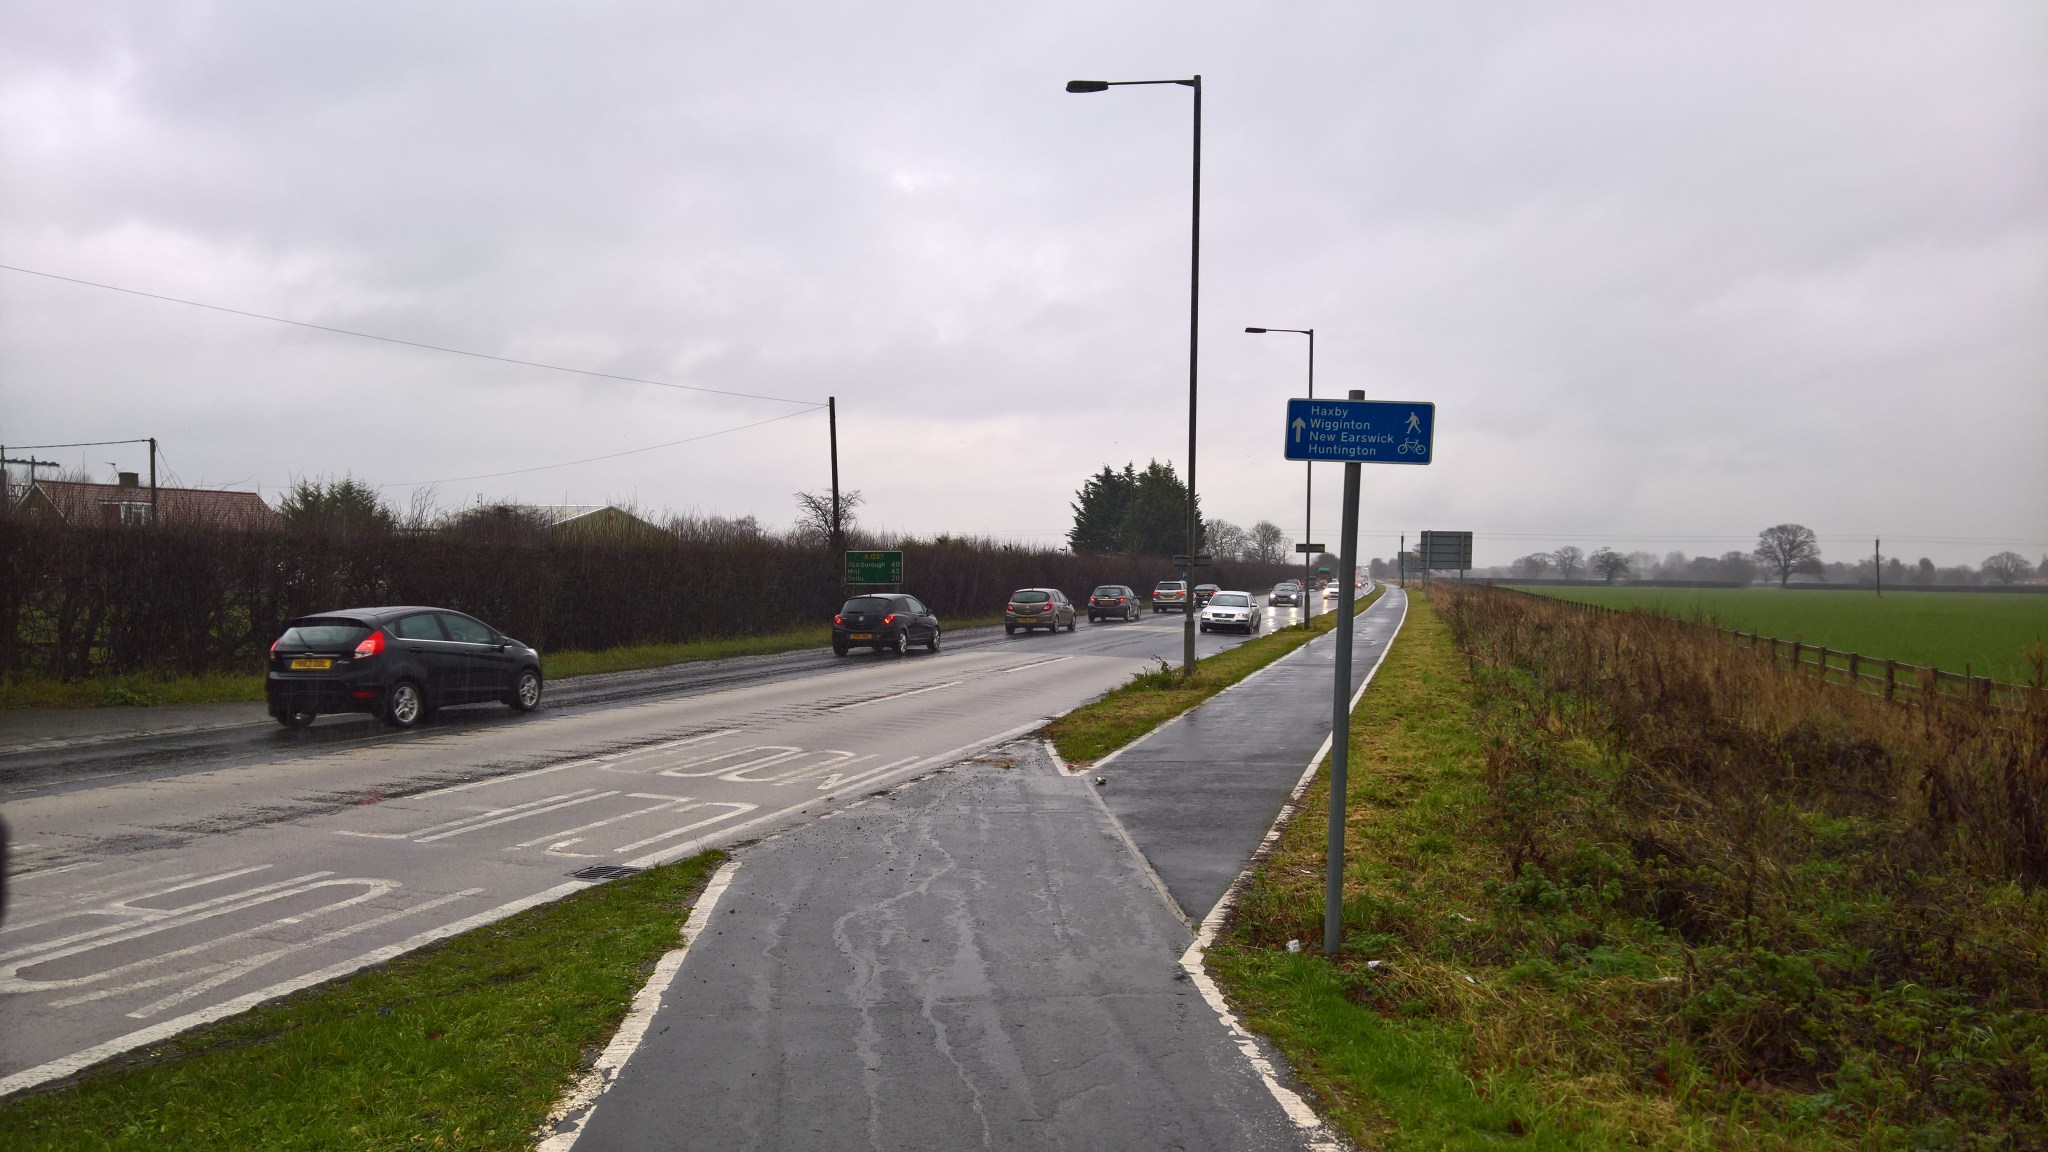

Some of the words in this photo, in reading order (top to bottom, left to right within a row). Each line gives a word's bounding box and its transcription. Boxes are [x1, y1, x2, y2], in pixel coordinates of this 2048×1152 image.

[1311, 405, 1349, 419] Haxby
[1310, 418, 1371, 431] Wigginton
[1309, 432, 1336, 441] New
[1340, 432, 1394, 444] Earswick
[1308, 444, 1377, 457] Huntington
